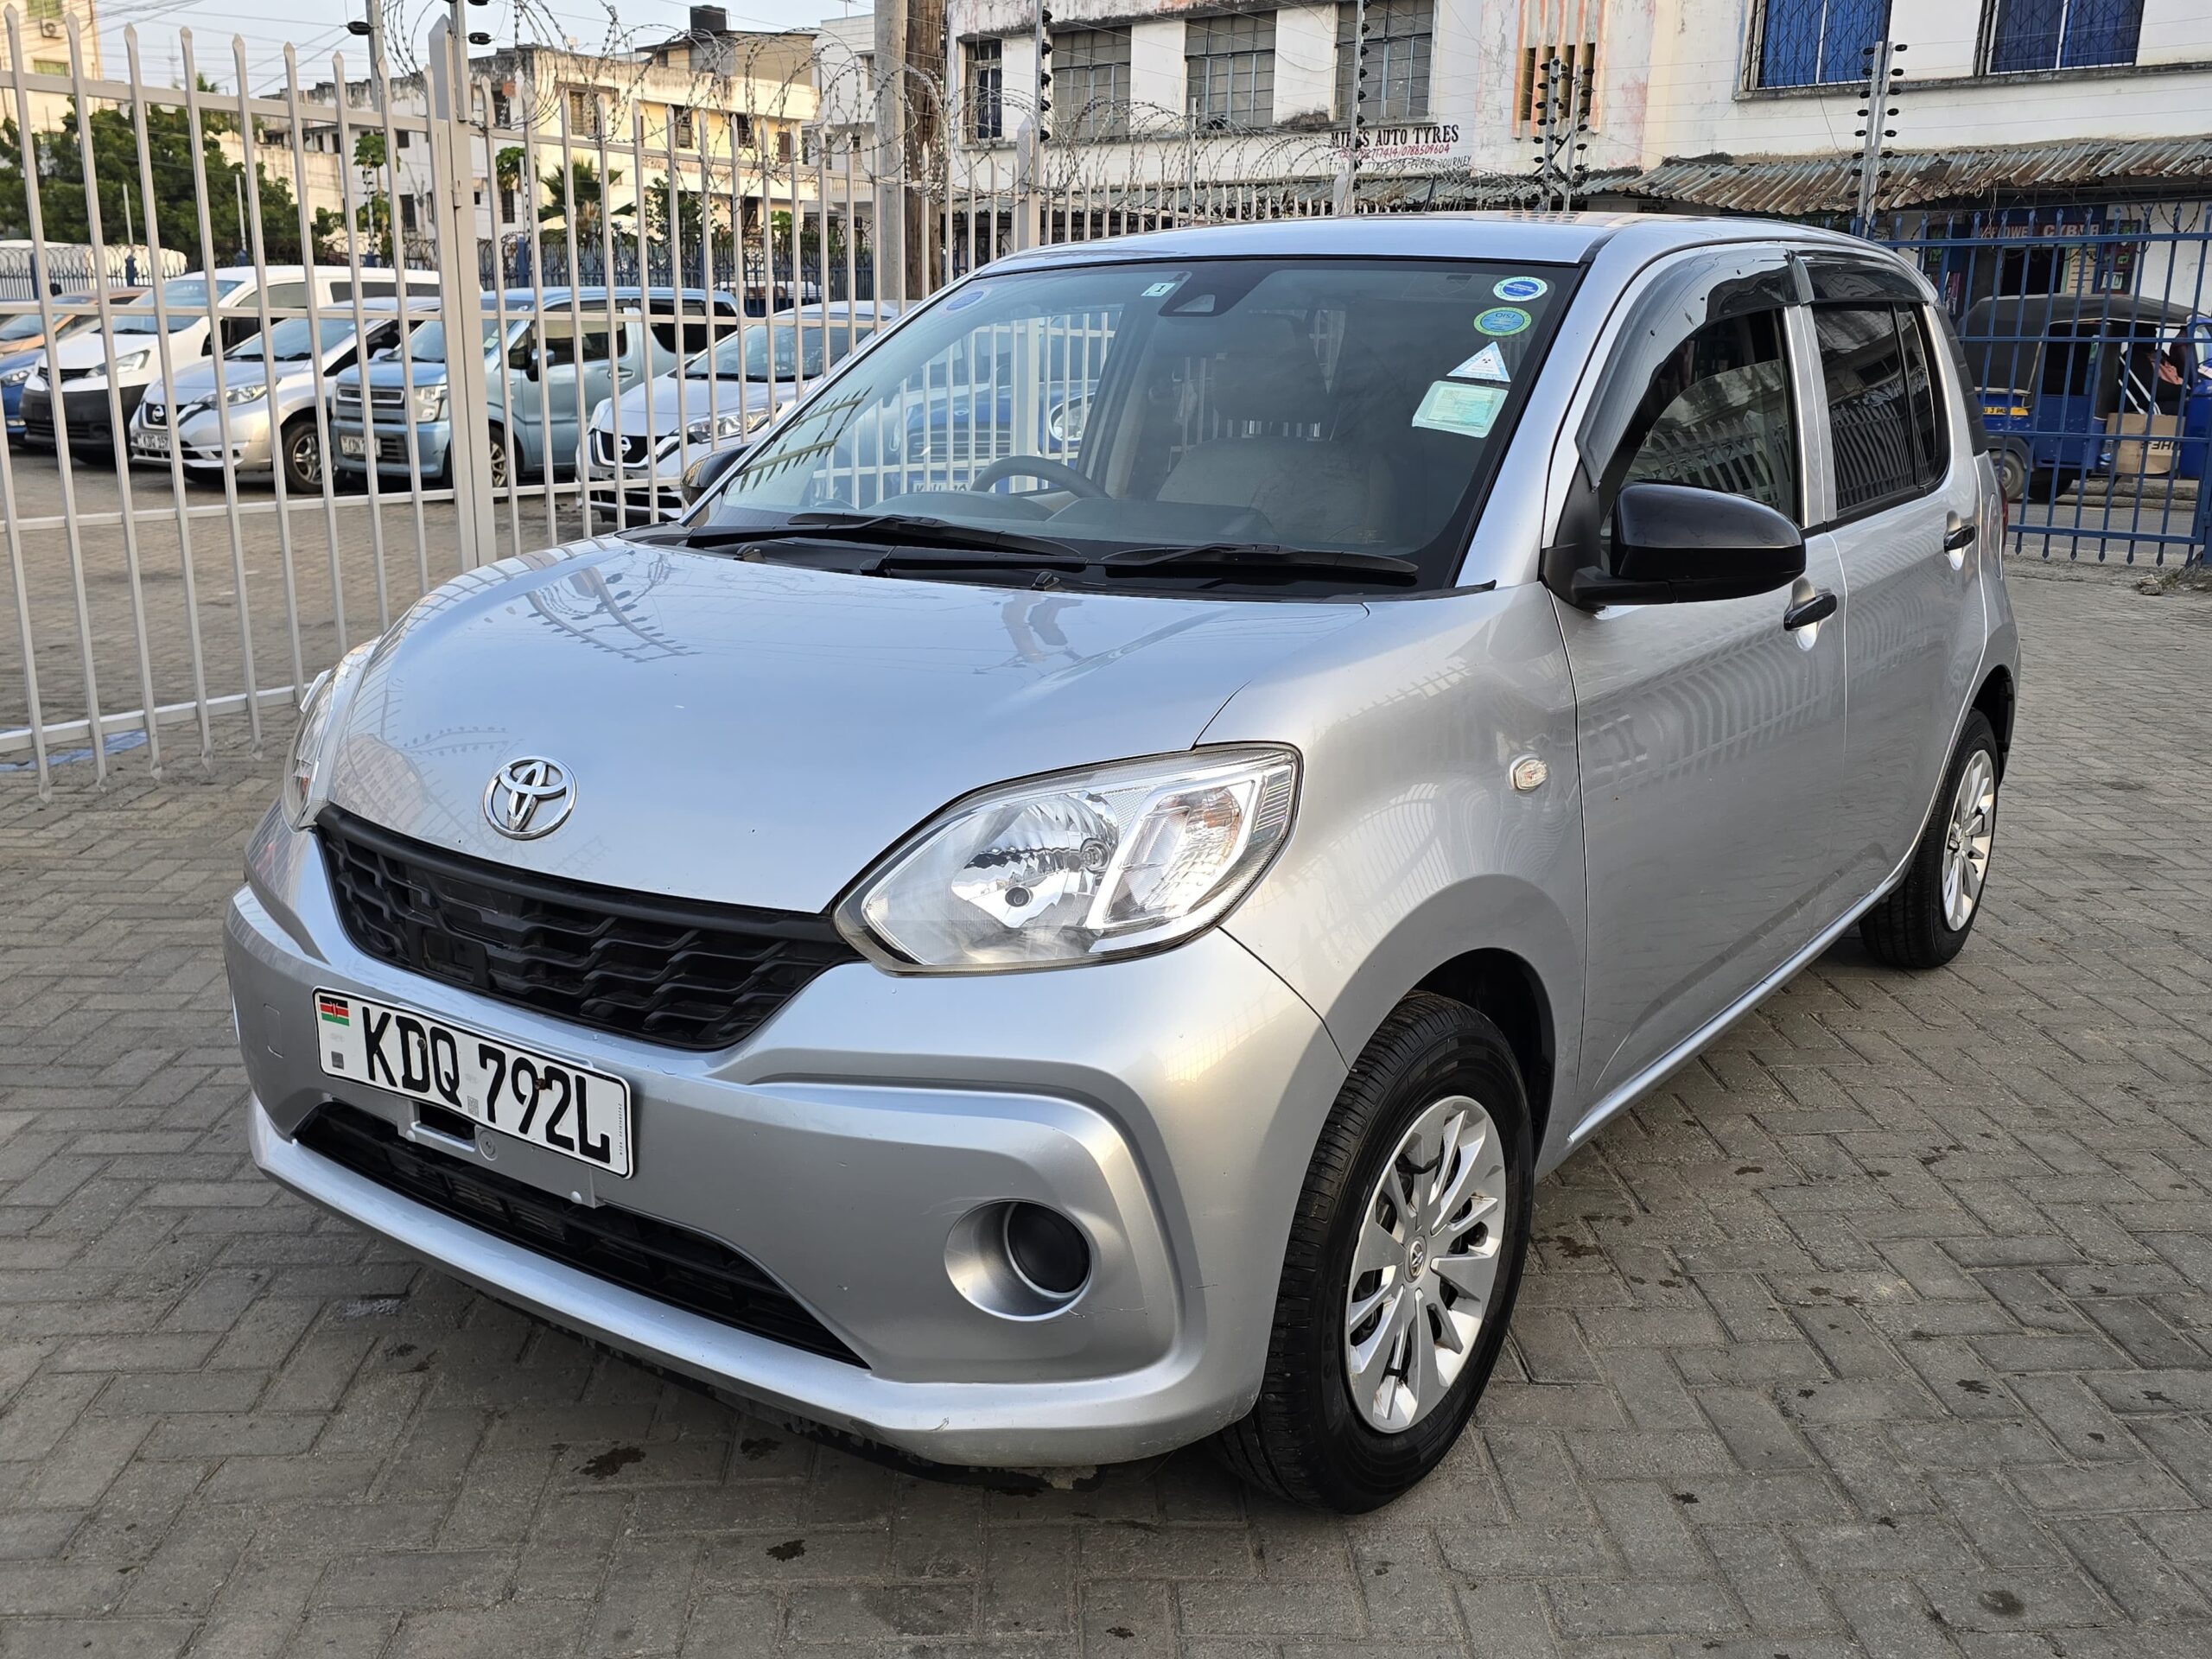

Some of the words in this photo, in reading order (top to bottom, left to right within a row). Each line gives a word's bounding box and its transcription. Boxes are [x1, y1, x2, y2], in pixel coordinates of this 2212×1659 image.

[1331, 130, 1370, 148] MIK'S
[1375, 129, 1408, 146] AUTO
[1413, 124, 1459, 144] TYRES
[1440, 156, 1471, 168] JOURNEY
[362, 1006, 462, 1108] KDQ
[478, 1043, 611, 1164] 792L
